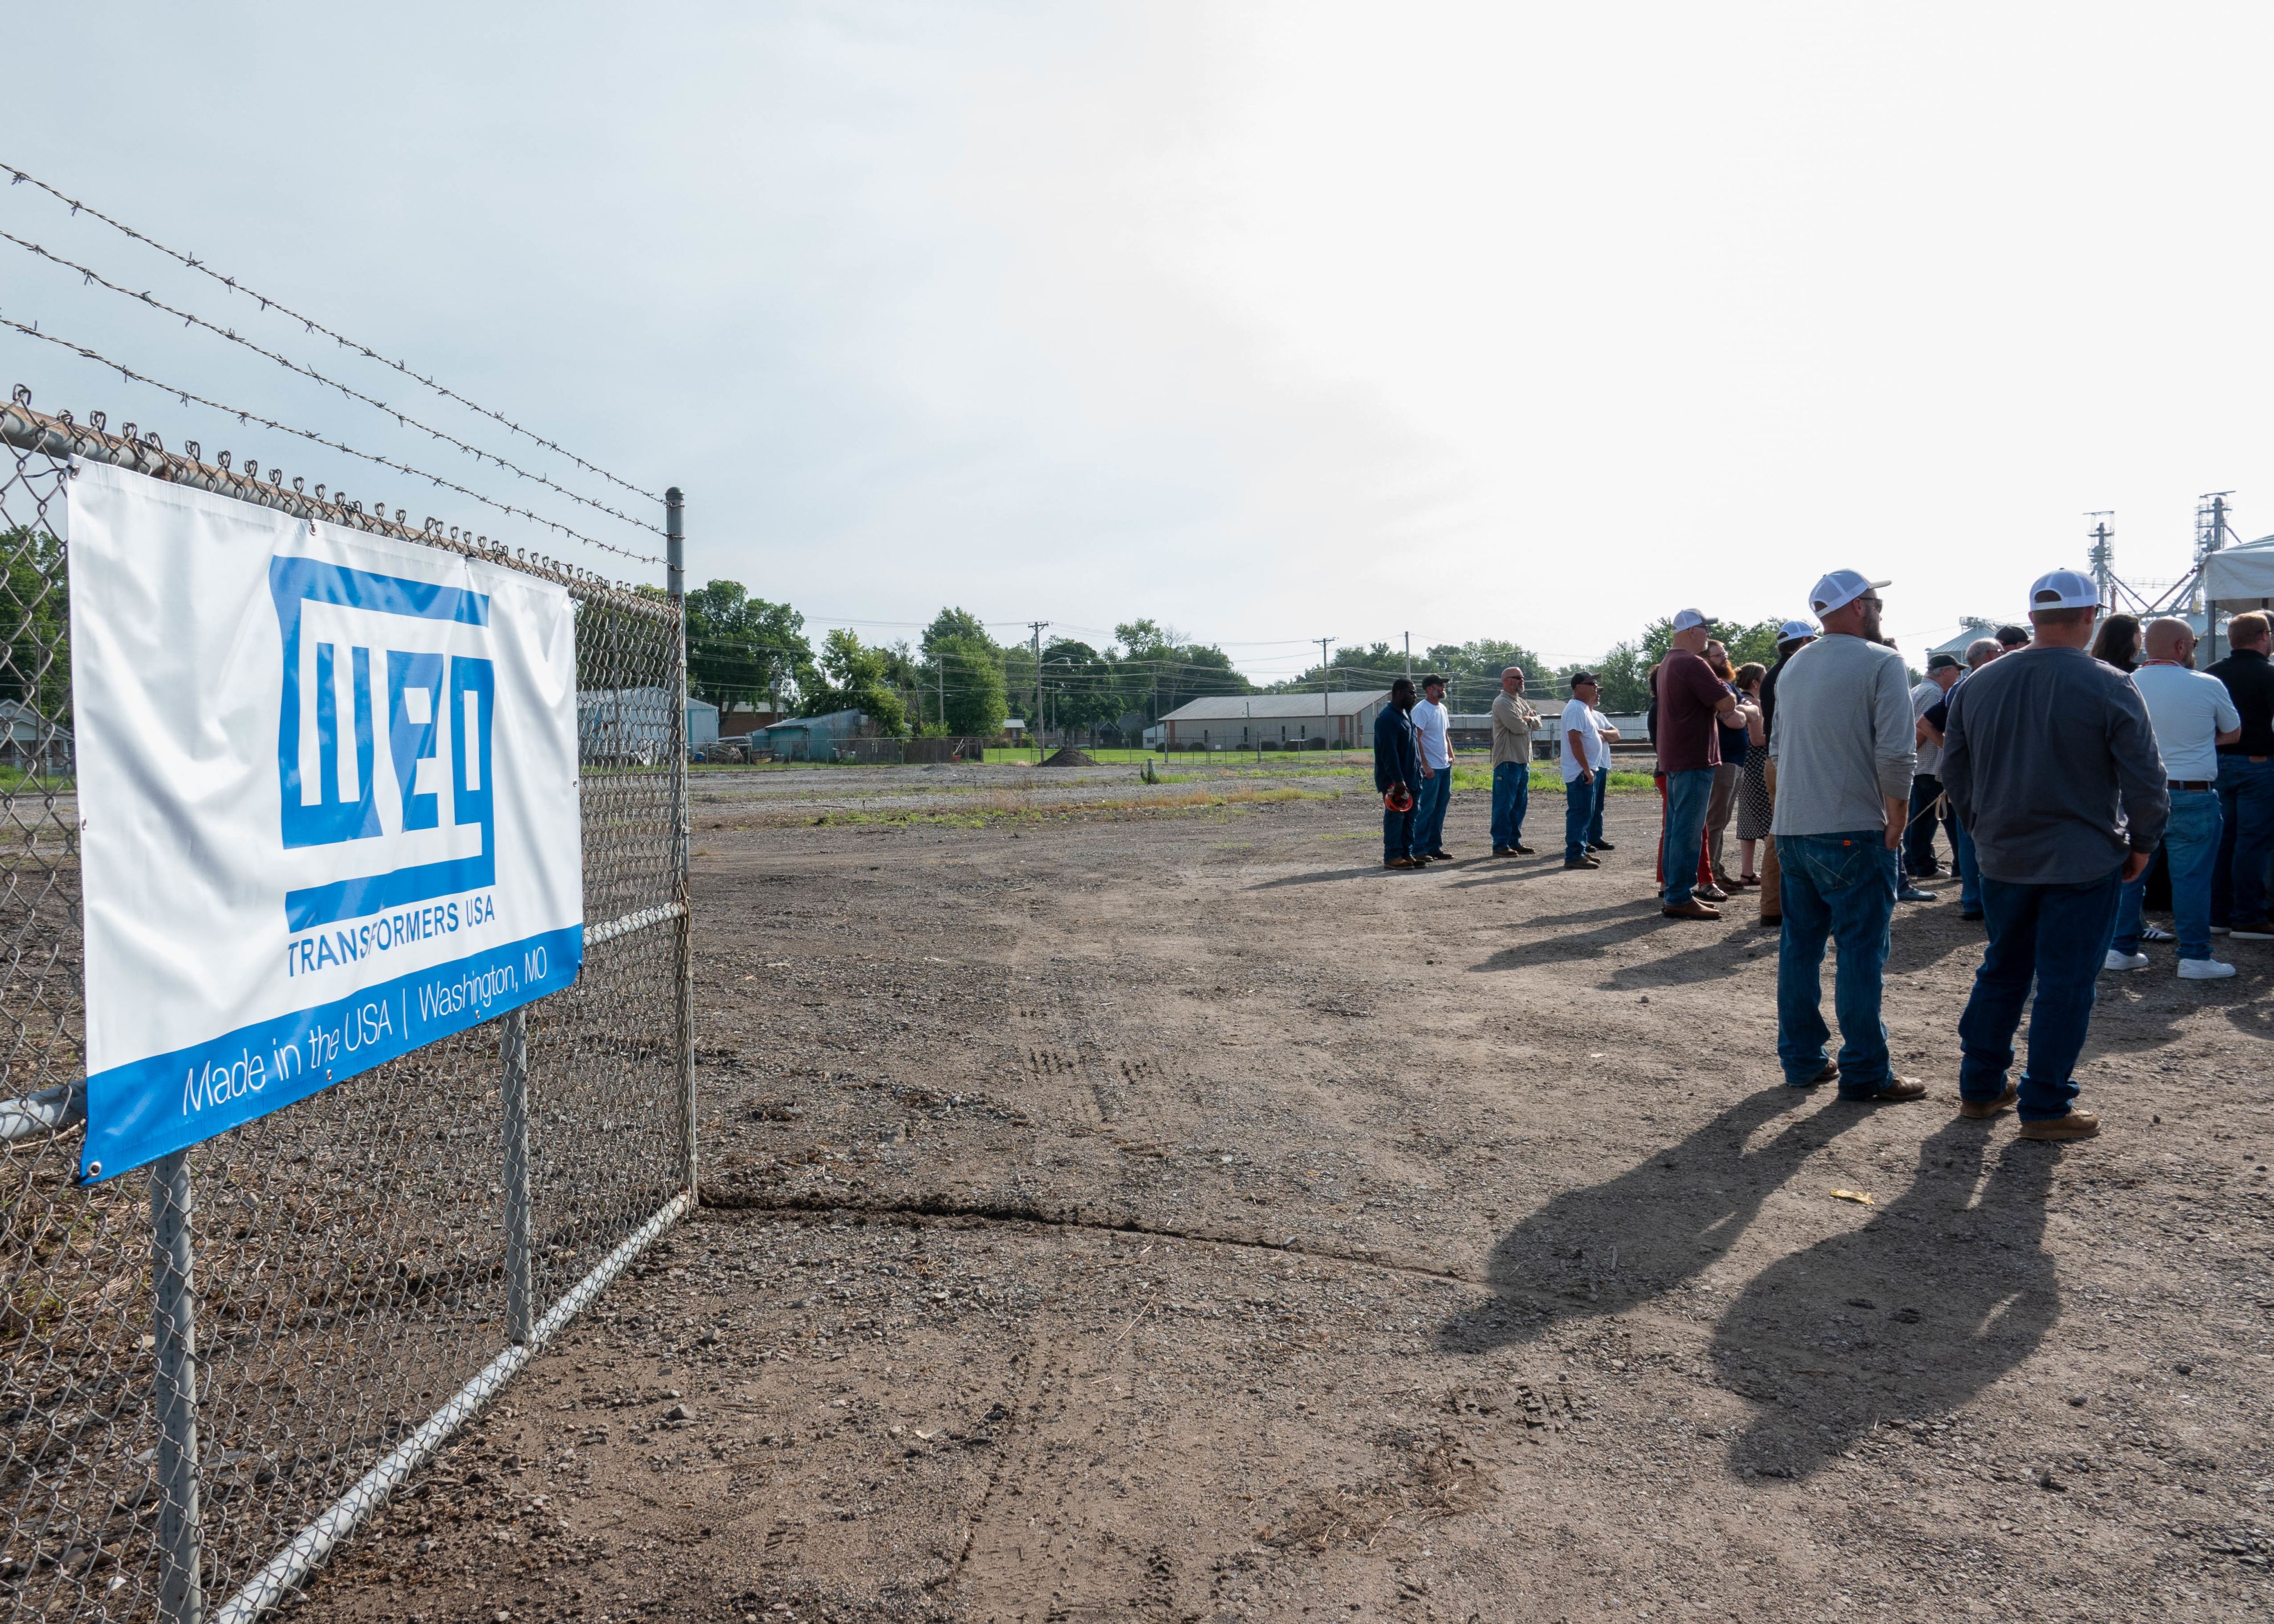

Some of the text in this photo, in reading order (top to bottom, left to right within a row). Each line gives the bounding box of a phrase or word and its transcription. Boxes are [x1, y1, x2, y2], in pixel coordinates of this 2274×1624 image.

[288, 895, 495, 977] TRANSFORMERS USA
[183, 1048, 266, 1115] Made
[273, 1038, 301, 1081] in
[308, 1025, 339, 1069] the
[345, 1000, 393, 1051] USA
[419, 965, 519, 1021] Washington,
[525, 946, 547, 984] MO
